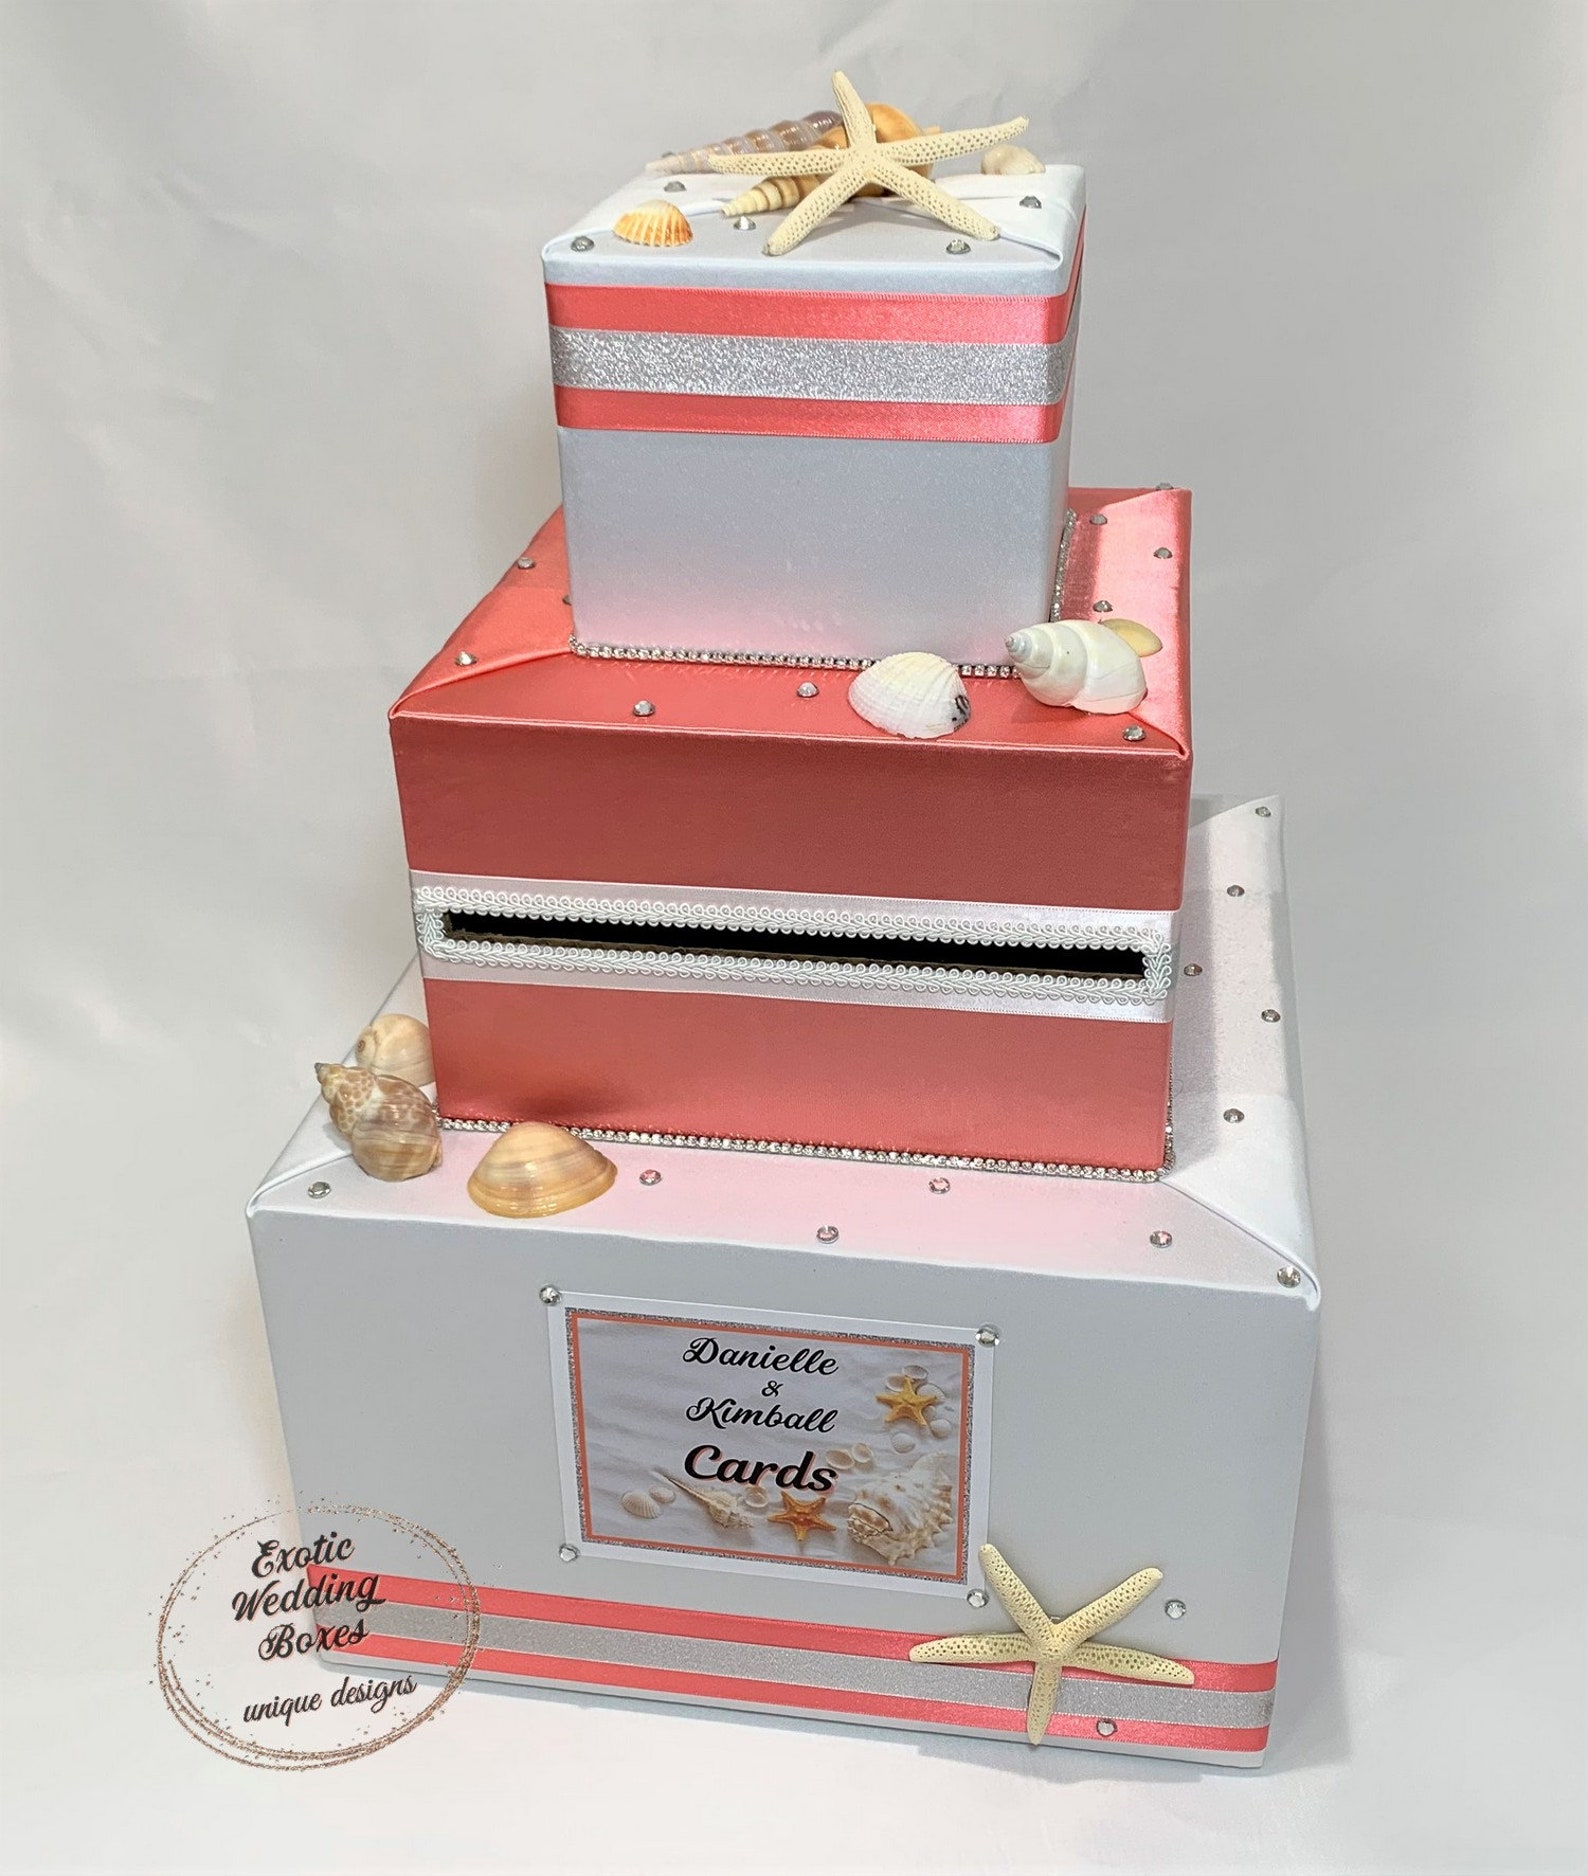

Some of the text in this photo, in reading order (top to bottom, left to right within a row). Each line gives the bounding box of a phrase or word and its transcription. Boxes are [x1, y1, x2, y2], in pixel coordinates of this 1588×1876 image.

[682, 1337, 838, 1376] Danielle
[761, 1380, 783, 1398] &
[685, 1397, 837, 1434] Kimball
[684, 1444, 838, 1493] Cards
